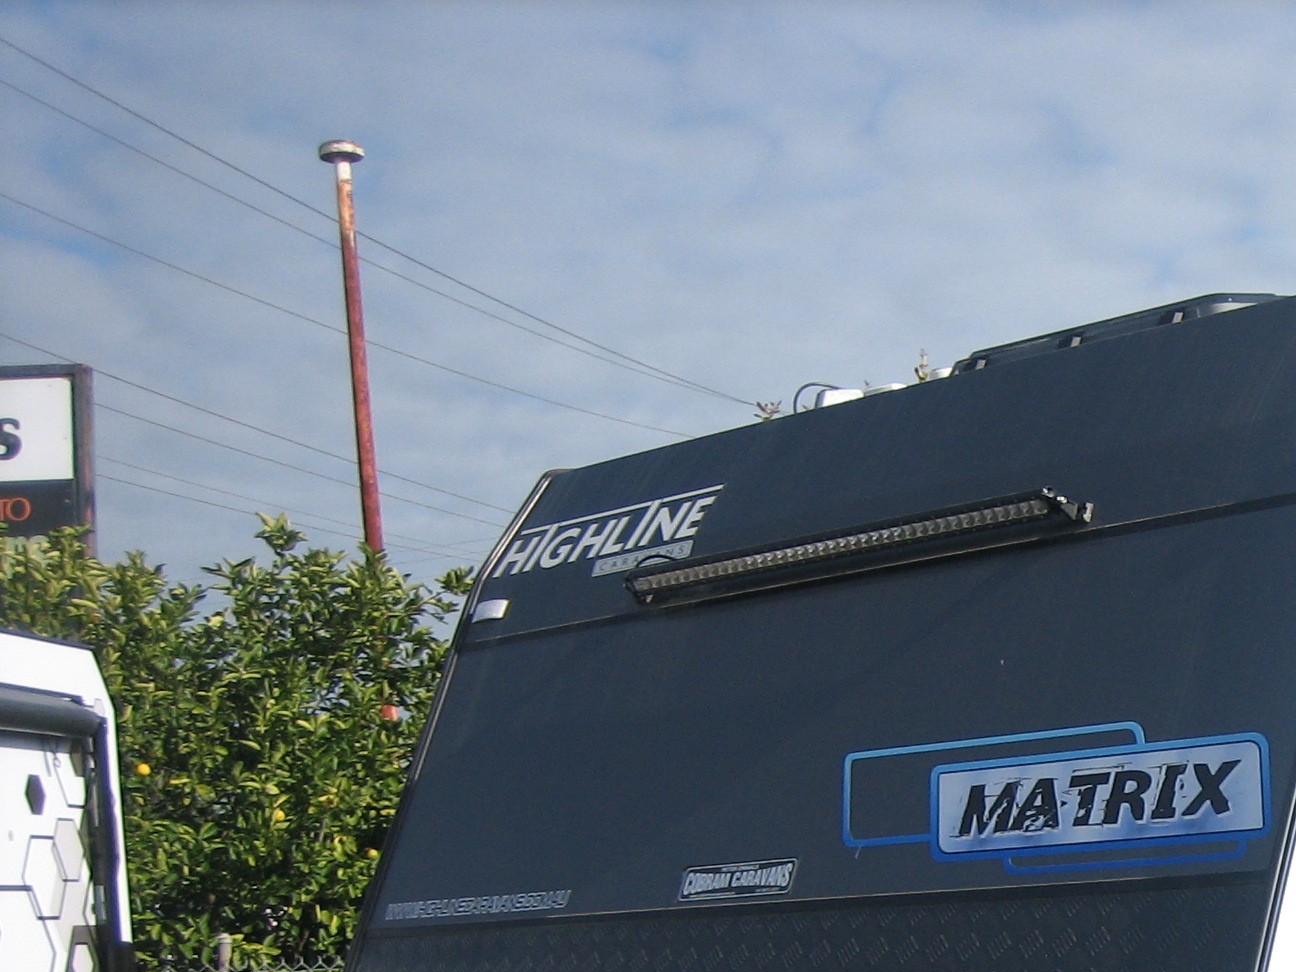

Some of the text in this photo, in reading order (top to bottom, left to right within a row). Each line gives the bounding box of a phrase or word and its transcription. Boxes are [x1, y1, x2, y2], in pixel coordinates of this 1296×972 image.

[492, 484, 723, 579] HIGHLINE
[599, 544, 687, 571] CARAANS
[958, 759, 1241, 838] MATRIX
[731, 863, 793, 888] CARAVANS
